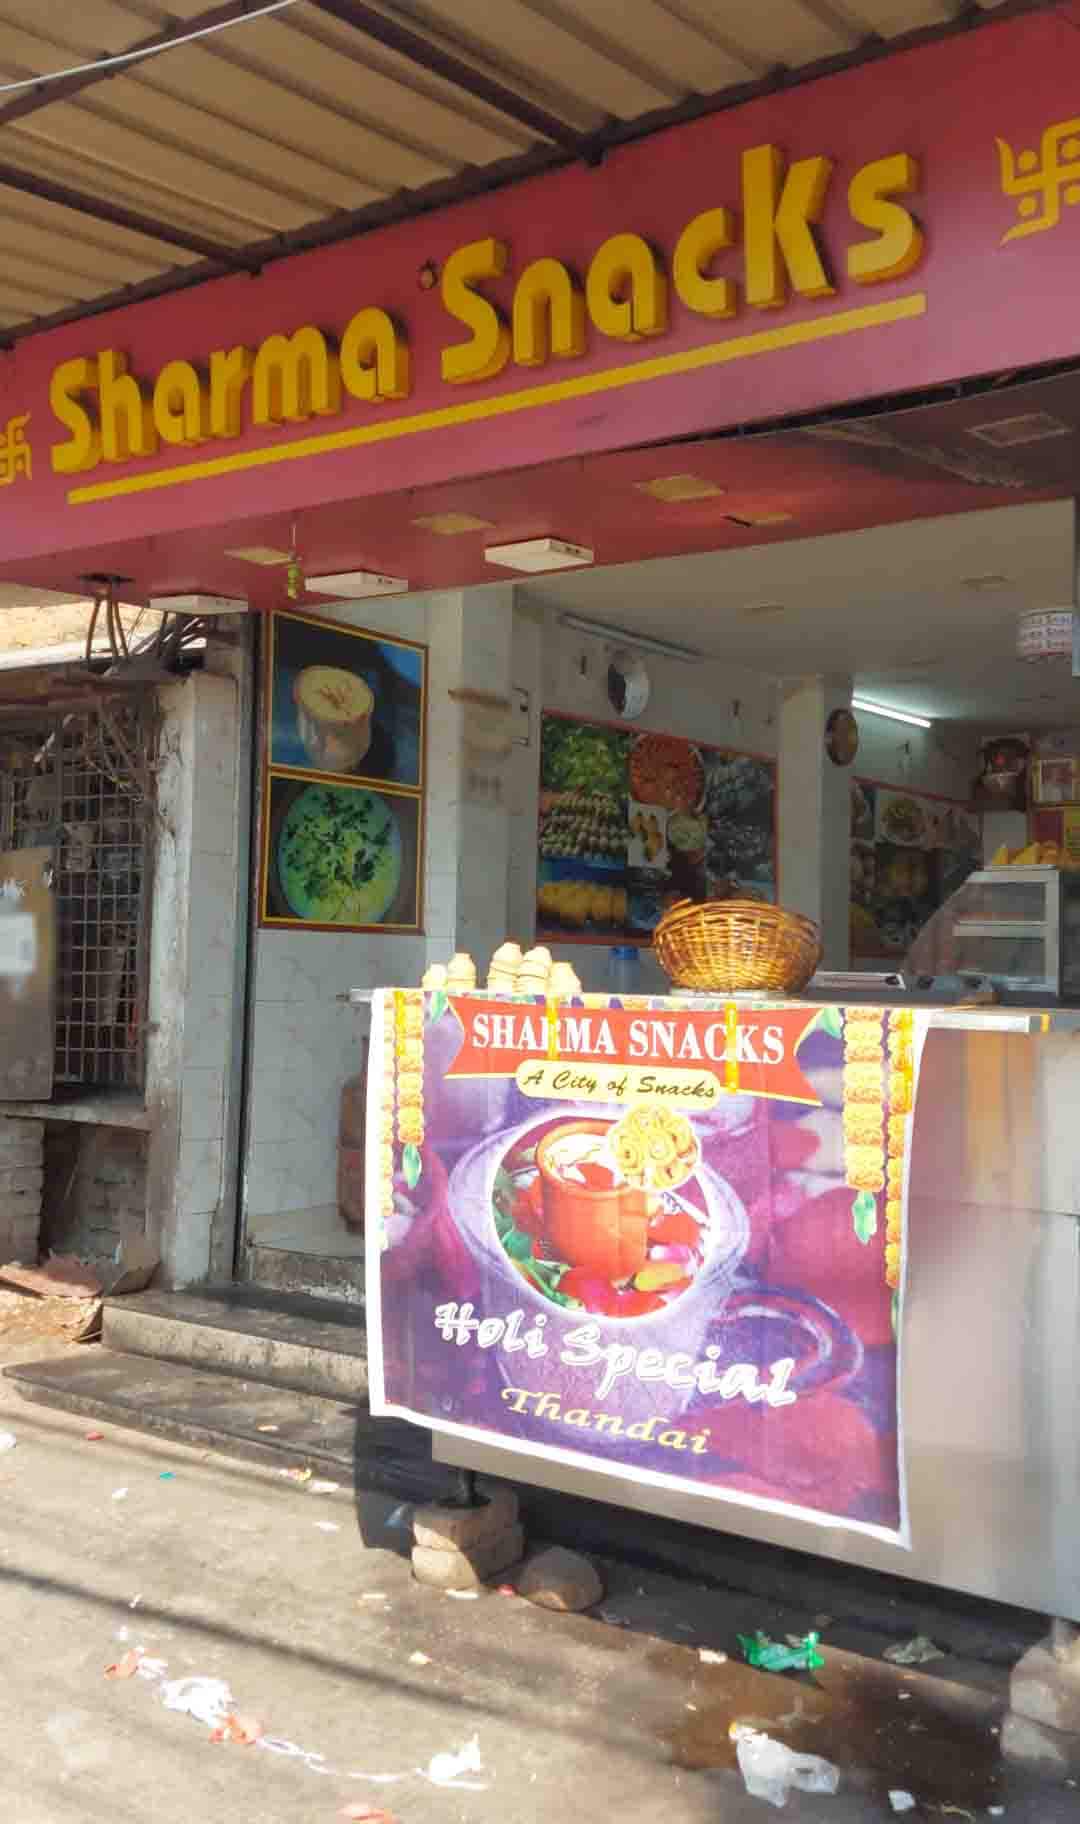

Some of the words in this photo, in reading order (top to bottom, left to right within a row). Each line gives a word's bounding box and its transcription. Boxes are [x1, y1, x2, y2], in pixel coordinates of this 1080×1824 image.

[50, 307, 410, 474] Sharma
[440, 145, 925, 384] Snacks
[629, 1020, 785, 1065] SNACKS
[524, 1068, 544, 1087] A
[551, 1070, 598, 1092] City
[606, 1076, 628, 1096] of
[637, 1075, 716, 1099] Snacks
[434, 1302, 547, 1358] Holi
[561, 1322, 798, 1407] Special
[501, 1388, 712, 1454] Thandai
